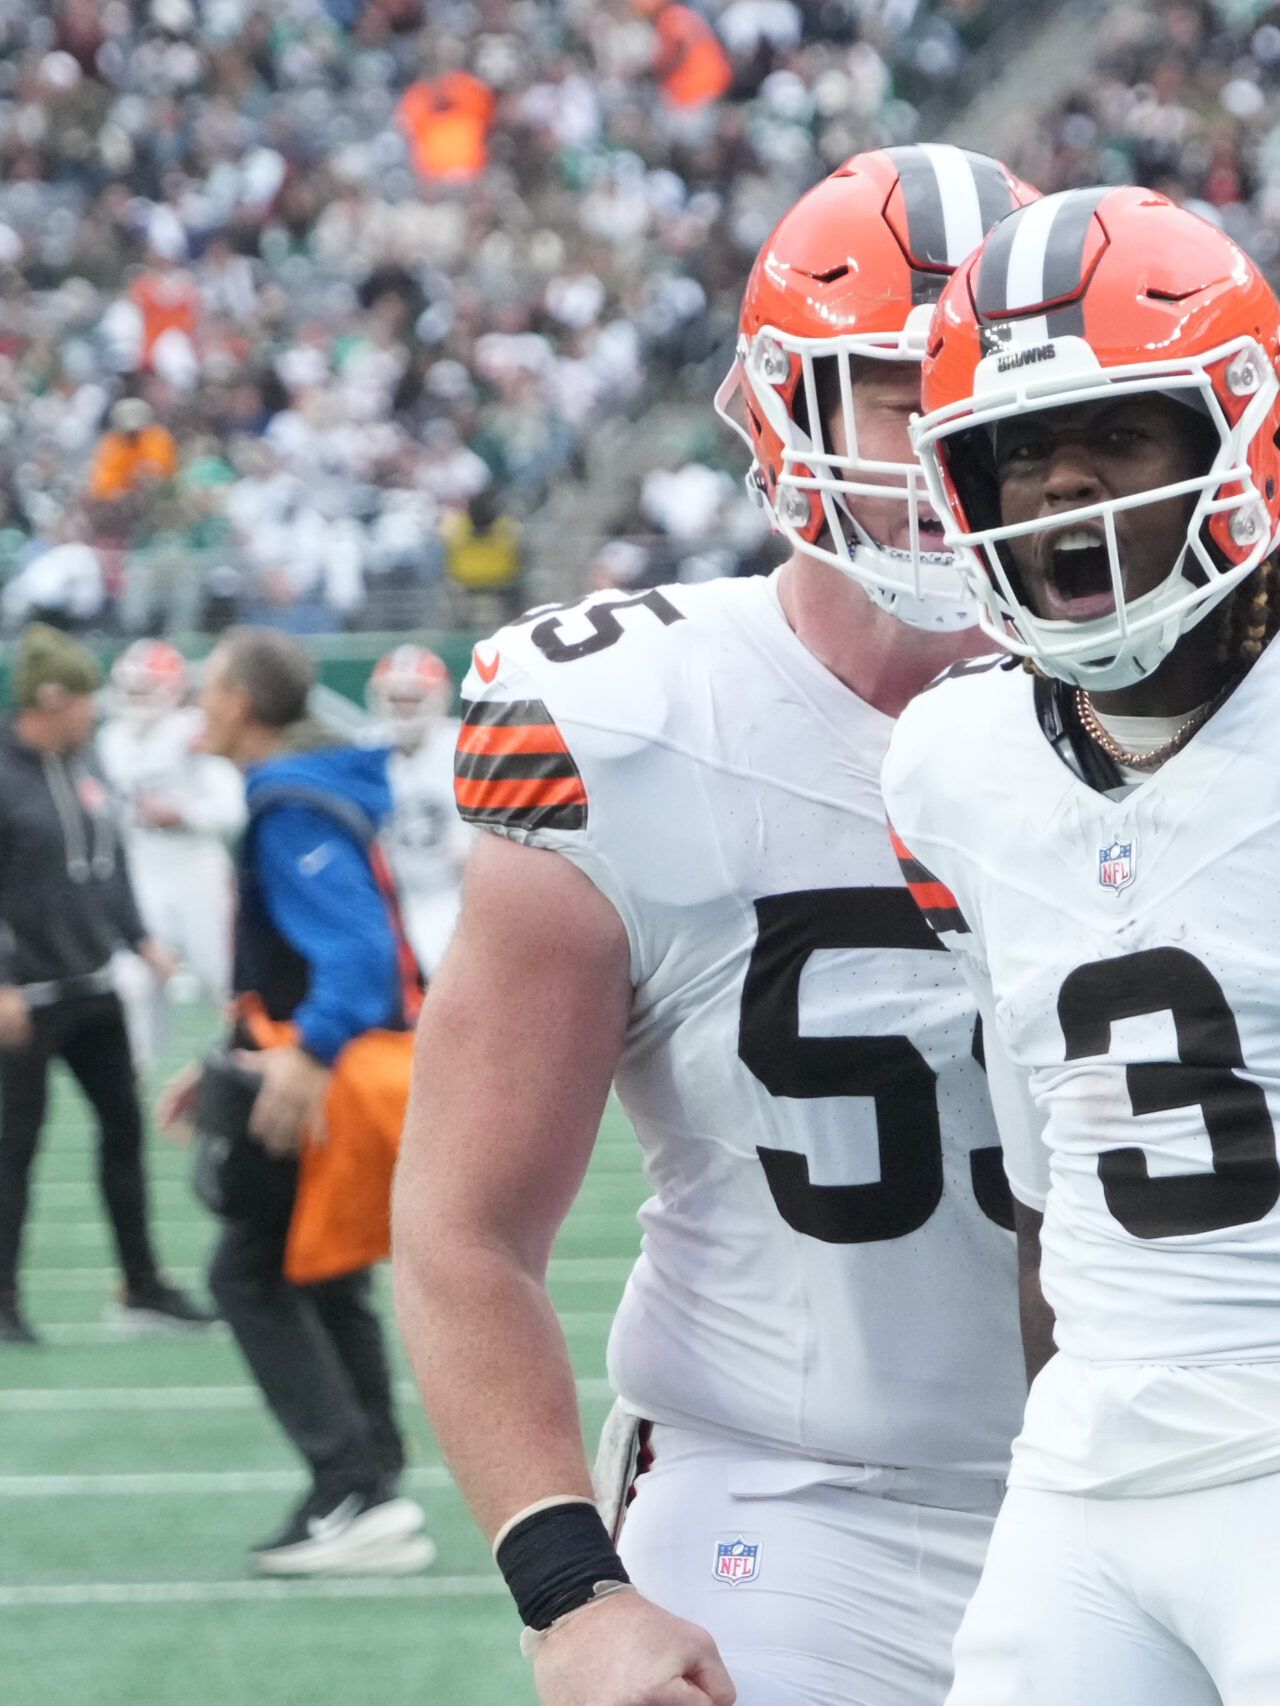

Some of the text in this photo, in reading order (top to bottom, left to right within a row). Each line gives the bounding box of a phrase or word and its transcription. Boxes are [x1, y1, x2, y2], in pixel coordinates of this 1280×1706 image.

[1102, 861, 1130, 884] NFL
[738, 886, 1016, 1244] 5
[719, 1557, 752, 1577] NFL
